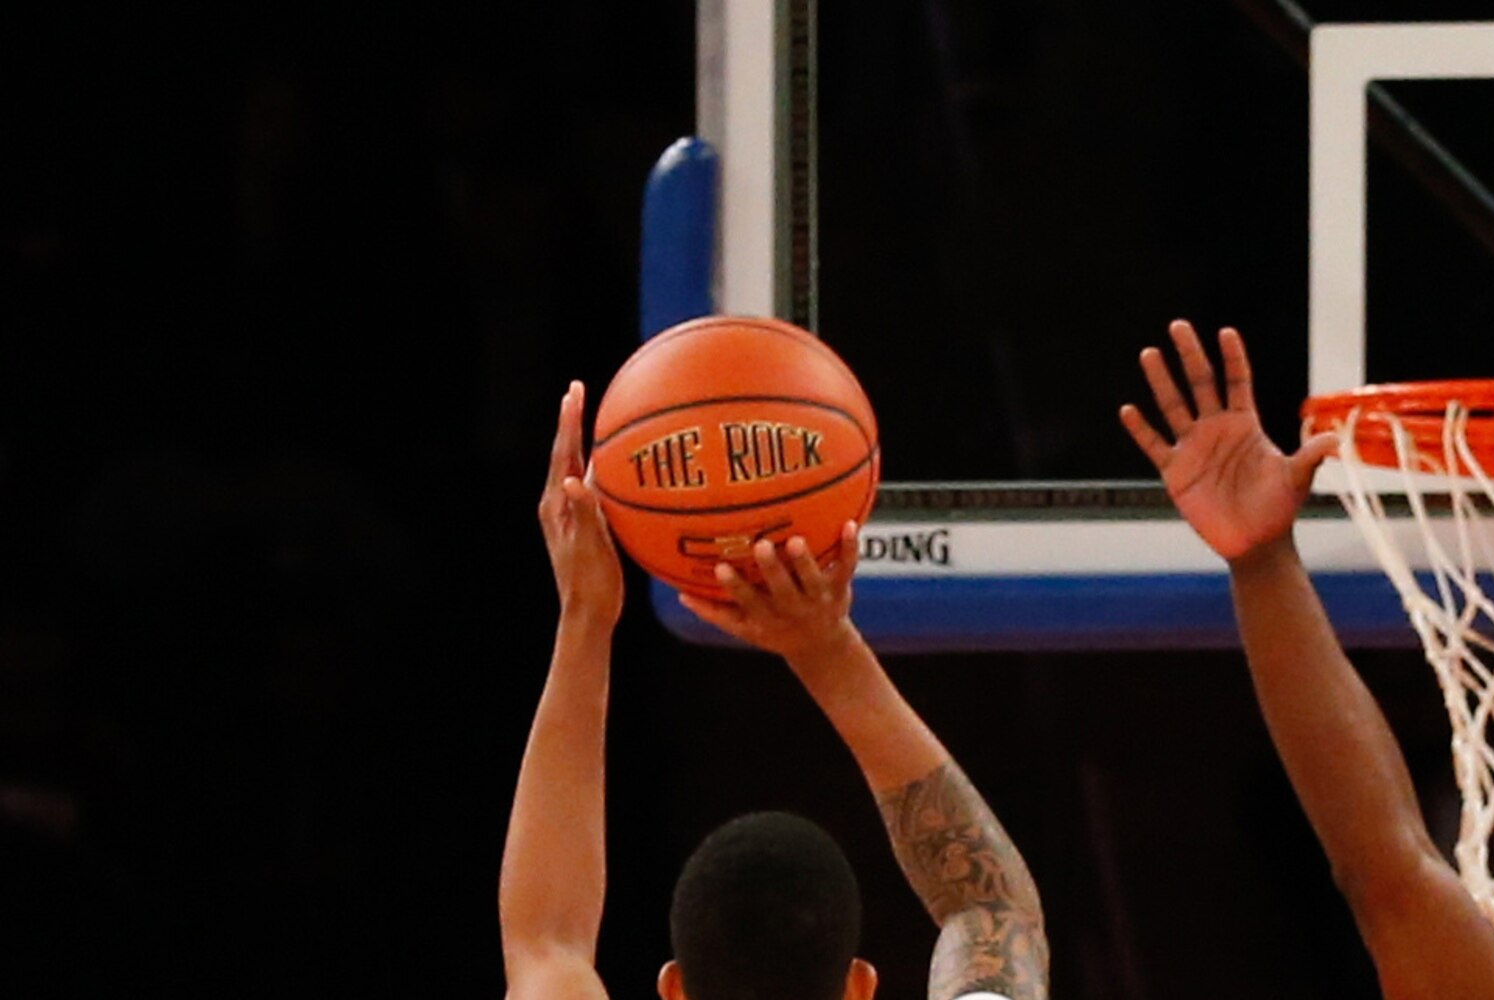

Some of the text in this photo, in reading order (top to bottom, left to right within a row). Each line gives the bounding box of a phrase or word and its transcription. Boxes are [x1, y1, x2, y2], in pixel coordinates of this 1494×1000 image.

[629, 419, 824, 489] THE ROCK
[859, 529, 949, 565] DING
